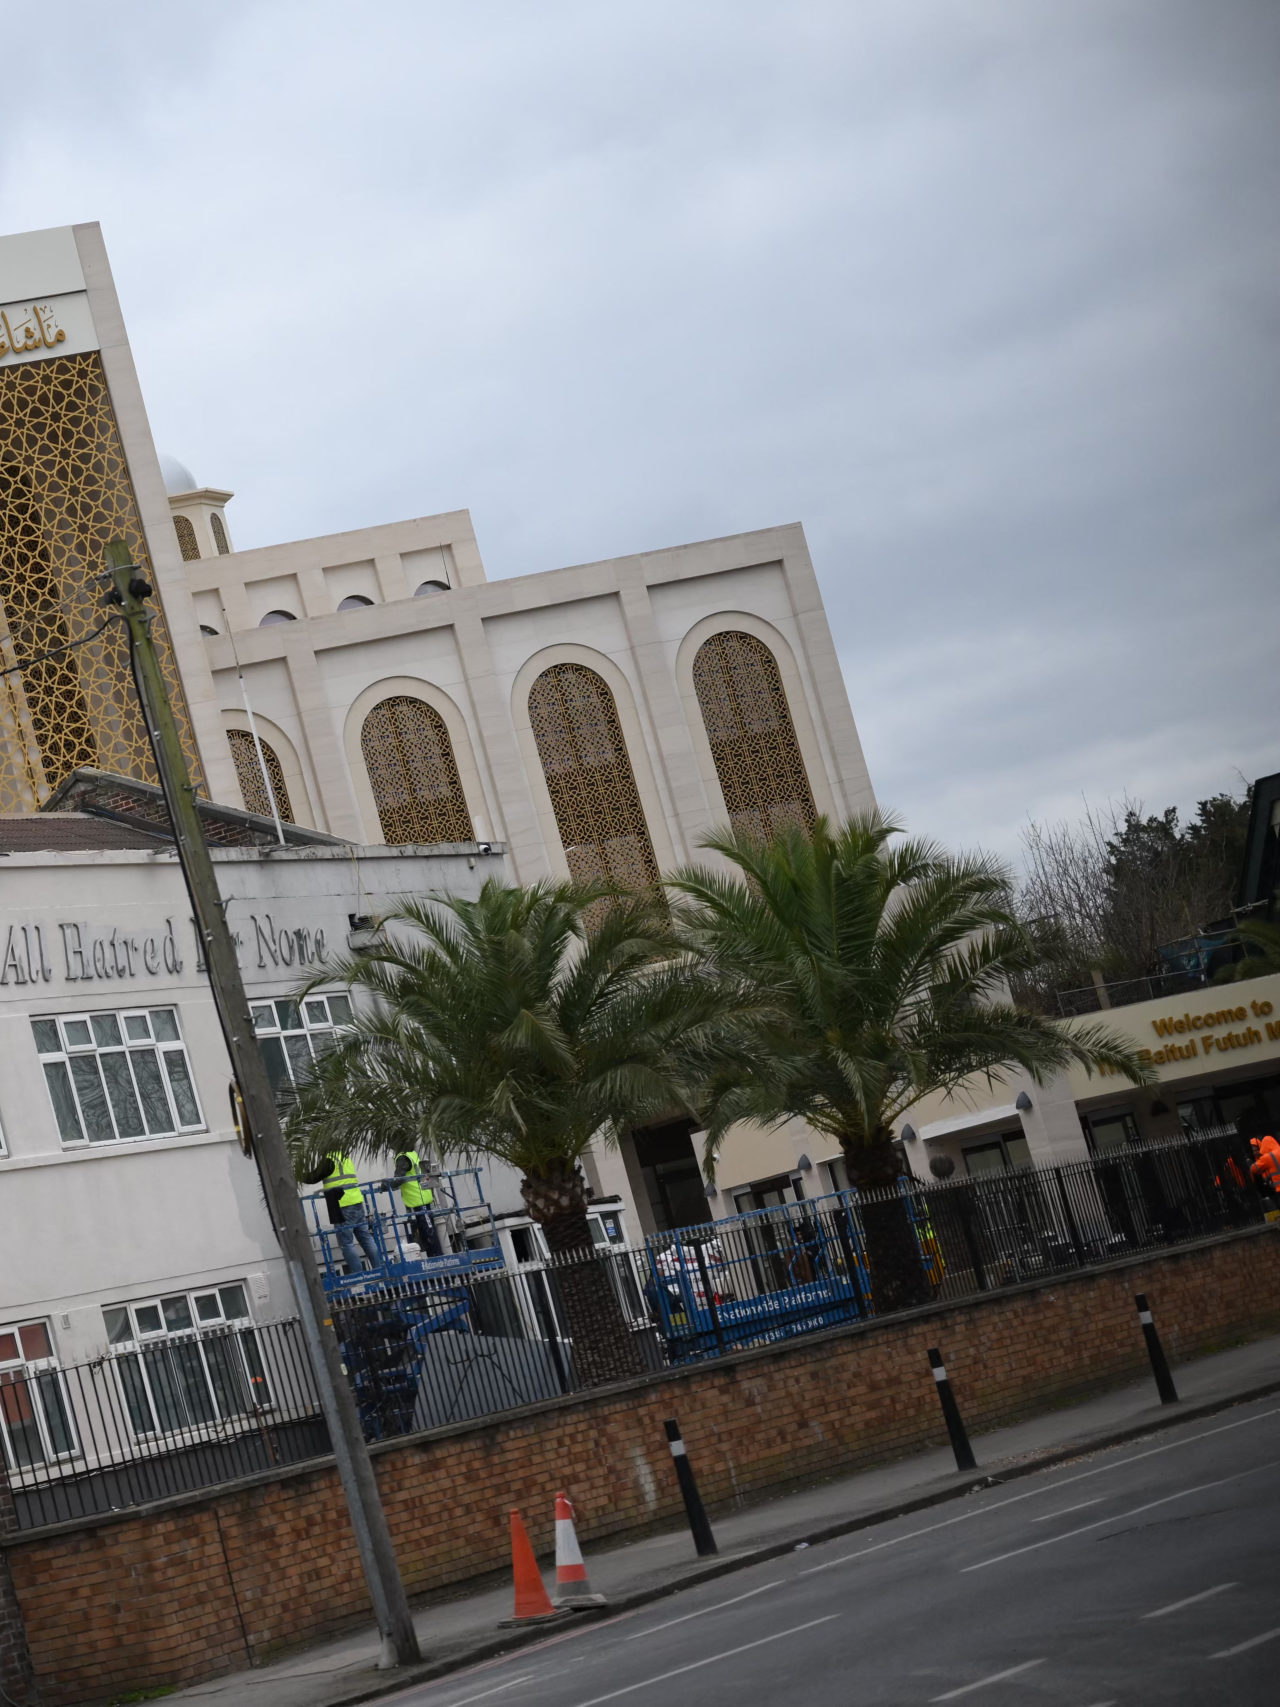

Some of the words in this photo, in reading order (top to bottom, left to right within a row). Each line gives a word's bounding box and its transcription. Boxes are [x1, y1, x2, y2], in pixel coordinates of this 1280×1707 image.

[0, 922, 53, 985] All
[58, 916, 184, 981] Hatred
[250, 914, 330, 968] None
[1151, 1006, 1248, 1038] Welcome
[1250, 1000, 1274, 1018] to
[1136, 1039, 1199, 1066] Baitul
[1201, 1026, 1263, 1055] Futuh
